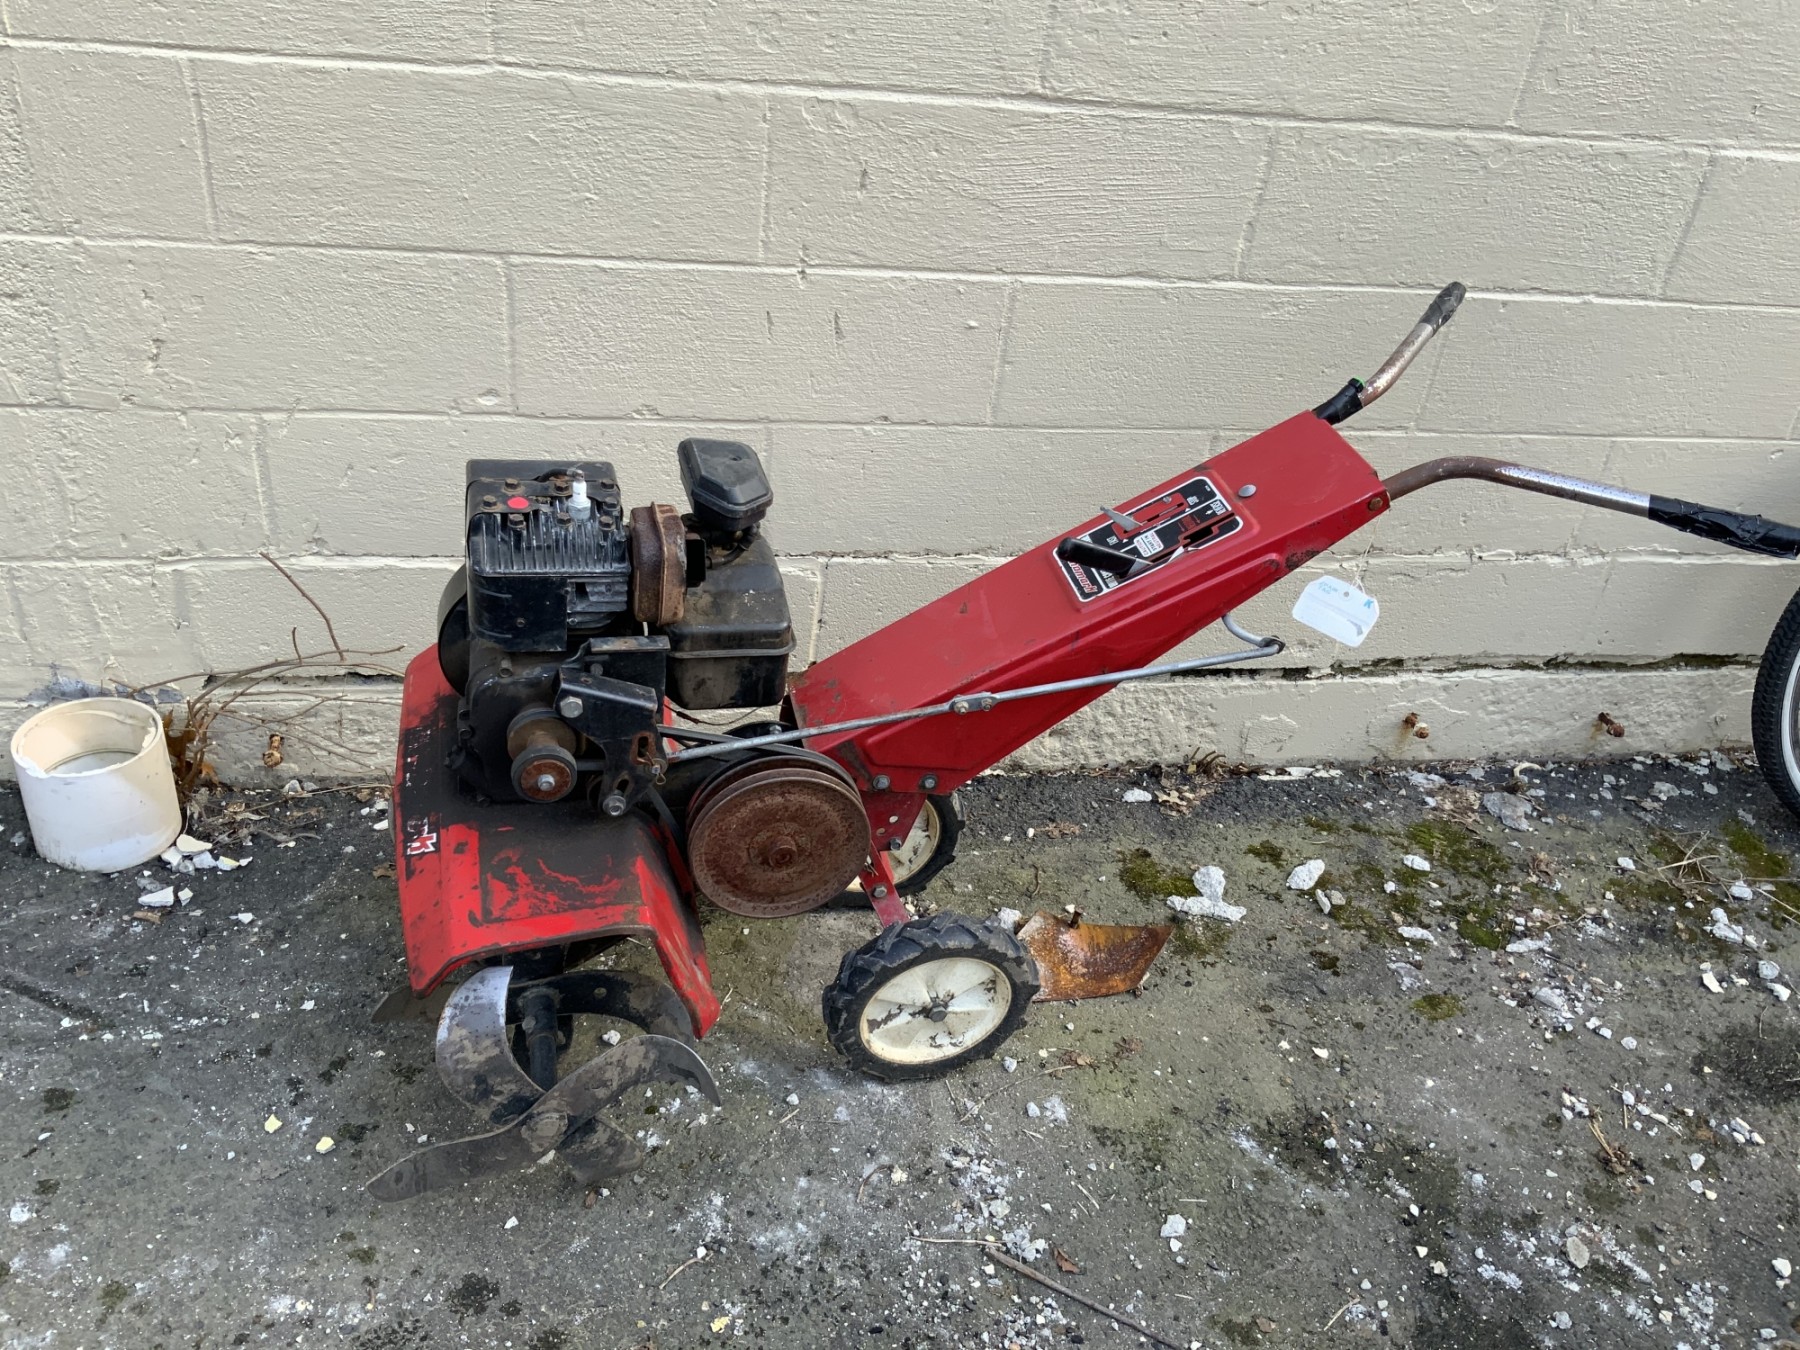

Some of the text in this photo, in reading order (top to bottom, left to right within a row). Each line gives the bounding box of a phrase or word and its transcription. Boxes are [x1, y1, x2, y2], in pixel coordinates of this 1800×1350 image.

[1136, 539, 1149, 556] CAUTION
[1147, 540, 1157, 551] START
[1150, 532, 1162, 549] NEUTRAL
